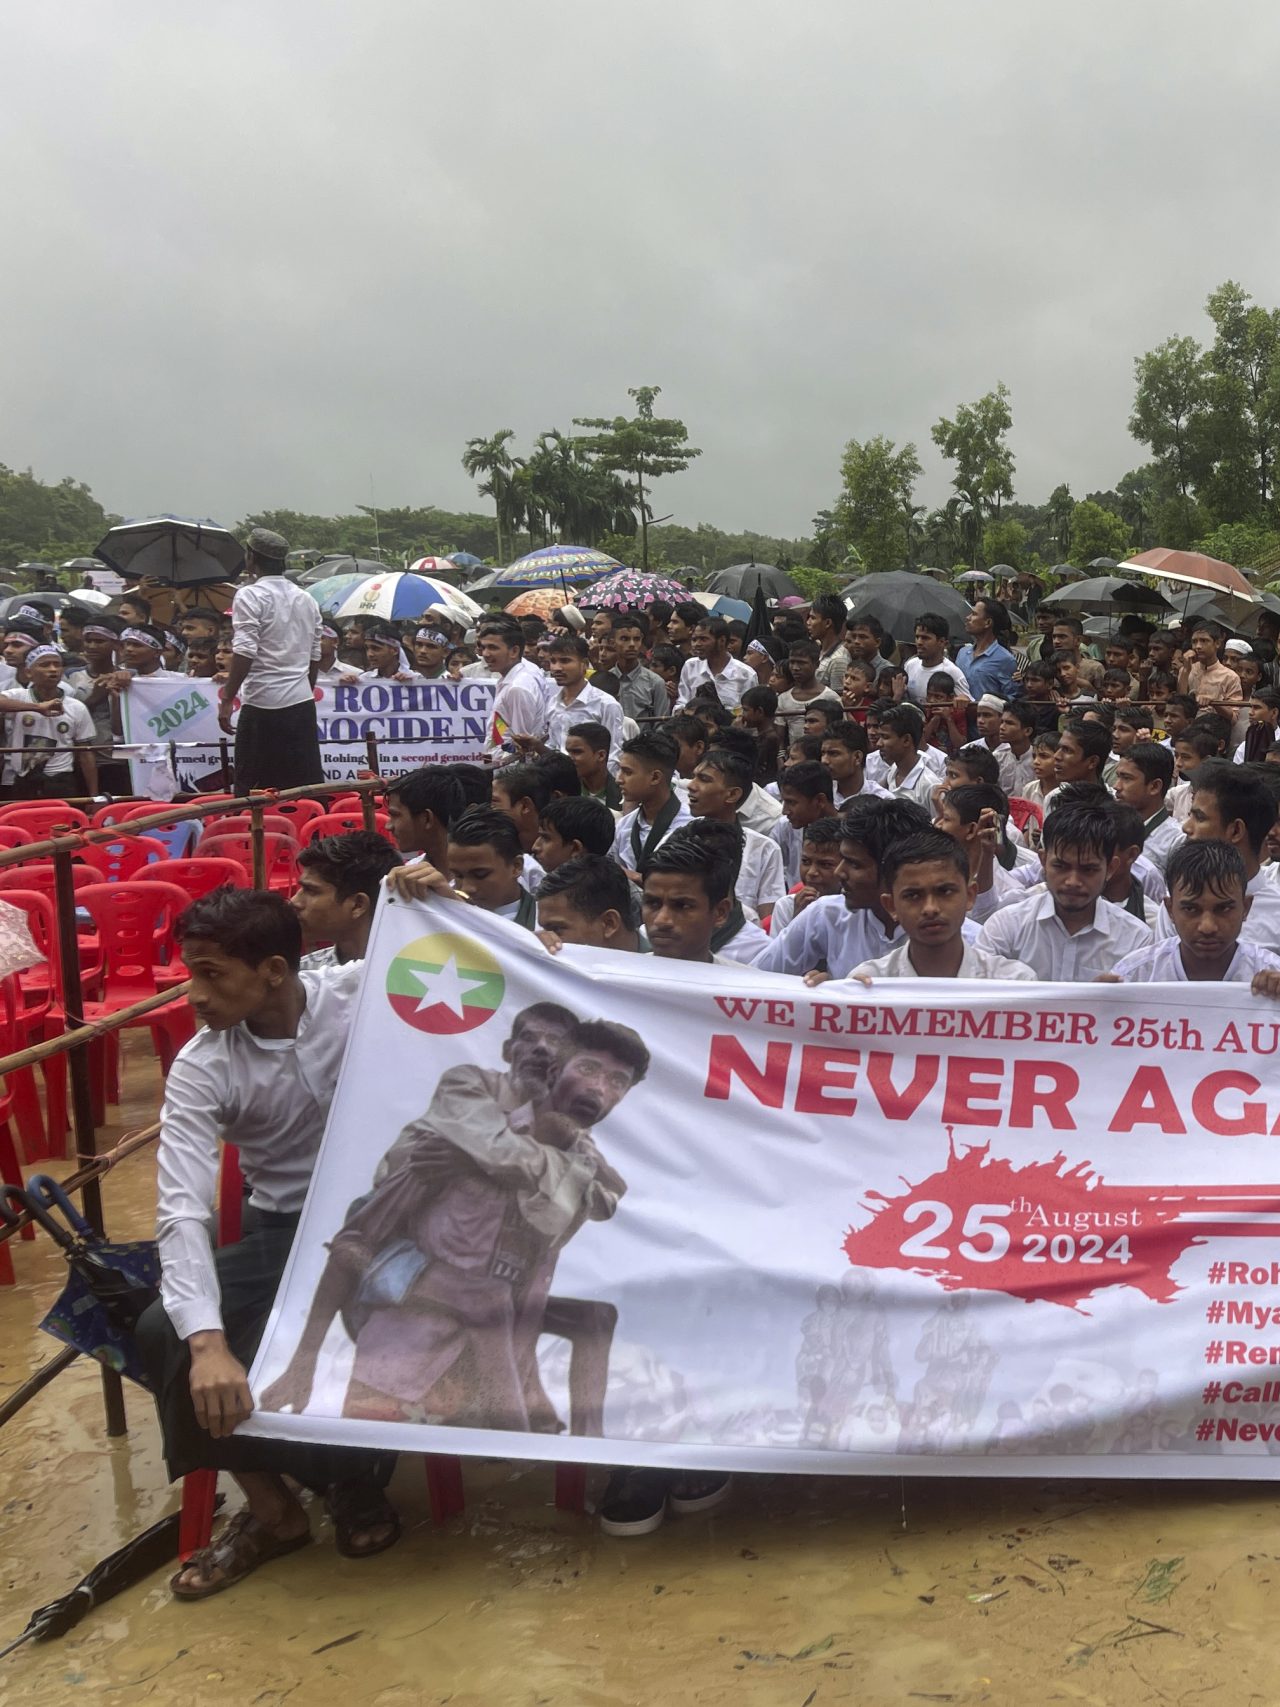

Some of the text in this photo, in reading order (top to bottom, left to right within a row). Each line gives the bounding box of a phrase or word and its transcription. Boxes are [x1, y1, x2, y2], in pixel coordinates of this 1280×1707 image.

[147, 691, 210, 738] 2024
[175, 753, 206, 764] rmed
[379, 753, 391, 763] in
[401, 753, 438, 763] second
[440, 752, 483, 765] genocid
[713, 996, 795, 1027] WE
[809, 1002, 1099, 1045] REMEMBER
[1111, 1017, 1204, 1052] 25th
[704, 1034, 1080, 1131] NEVER
[1025, 1203, 1143, 1232] August
[1022, 1233, 1133, 1265] 2024
